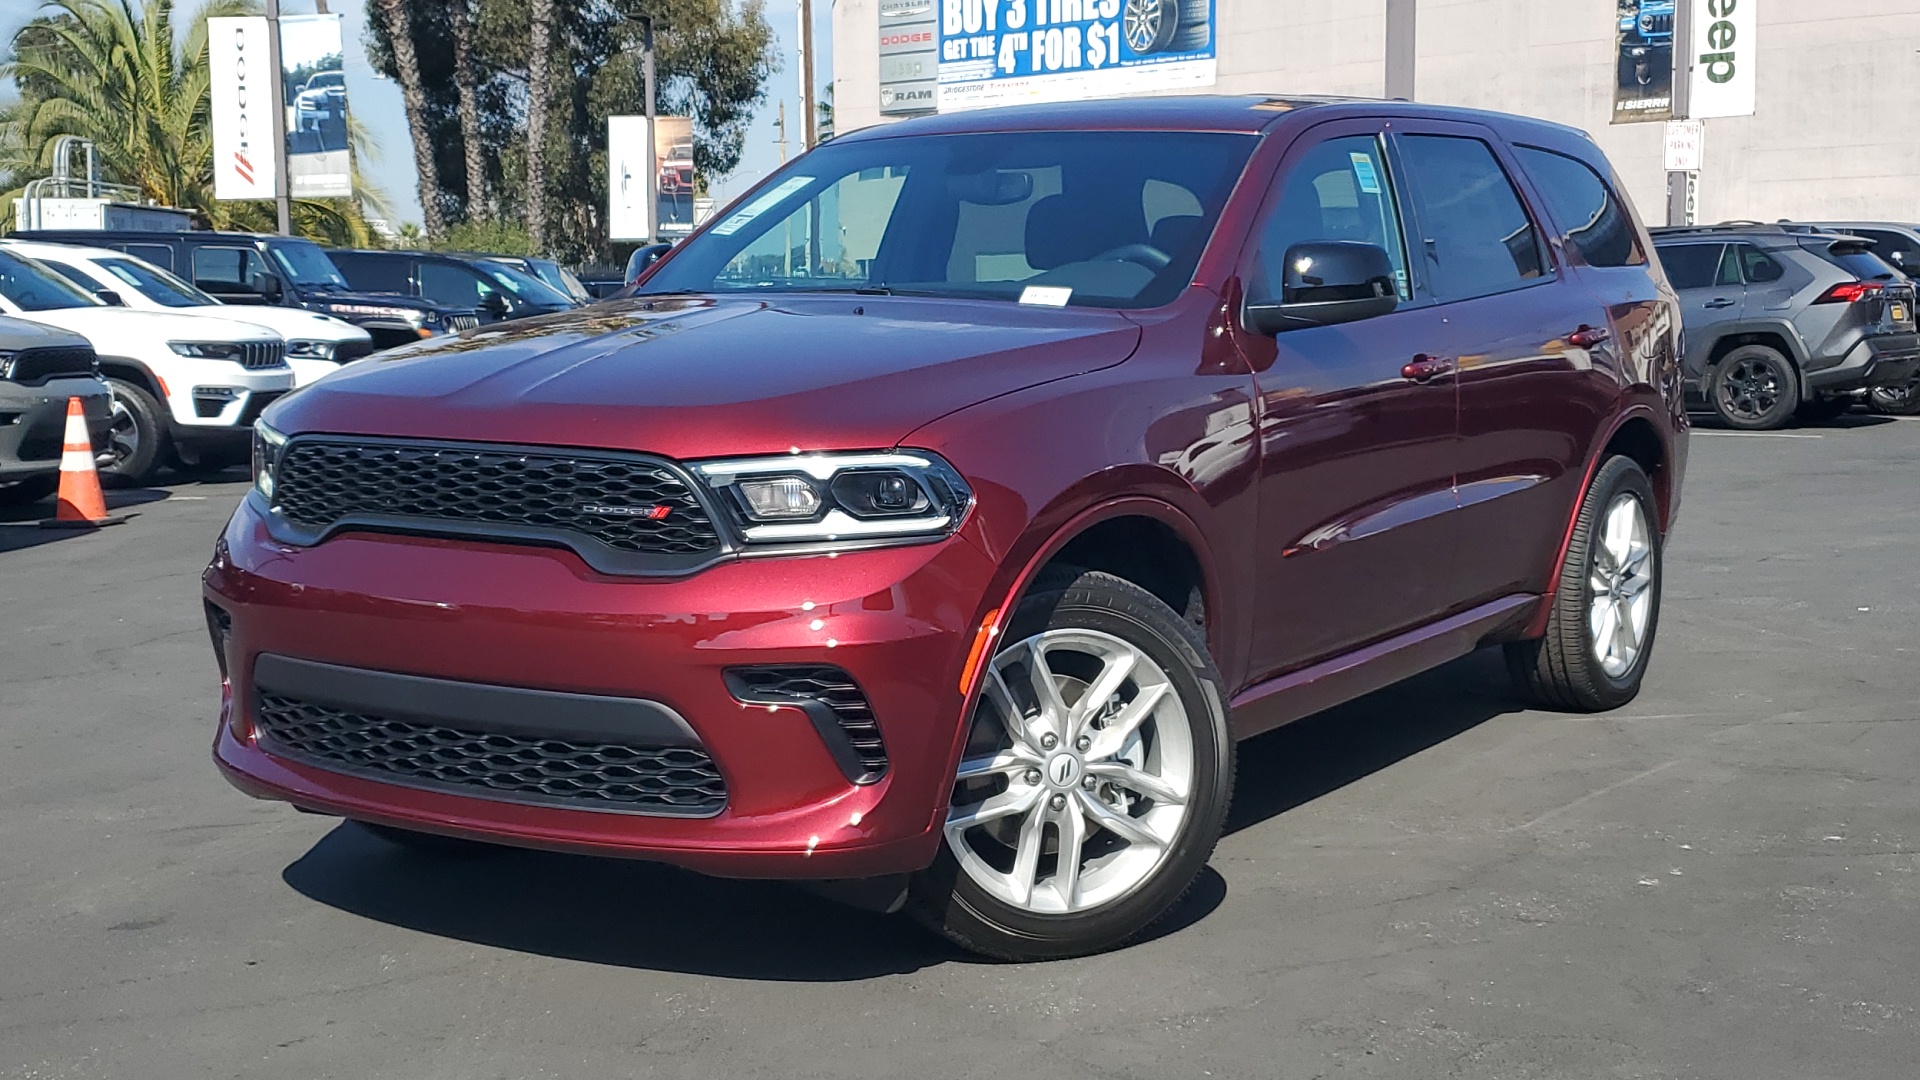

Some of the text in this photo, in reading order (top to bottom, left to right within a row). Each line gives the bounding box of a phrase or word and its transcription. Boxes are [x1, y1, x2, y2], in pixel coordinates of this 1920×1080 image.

[881, 0, 930, 11] CHRYSLER
[943, 0, 998, 36] BUY
[1006, 0, 1027, 29] 3
[881, 32, 932, 46] DODGE
[1700, 0, 1736, 83] eep
[943, 38, 968, 61] GET
[969, 35, 996, 58] THE
[1031, 26, 1082, 72] FOR
[1087, 21, 1120, 69] $1
[895, 90, 933, 102] RAM
[1623, 97, 1670, 111] SIERRA
[583, 505, 656, 516] DODGE
